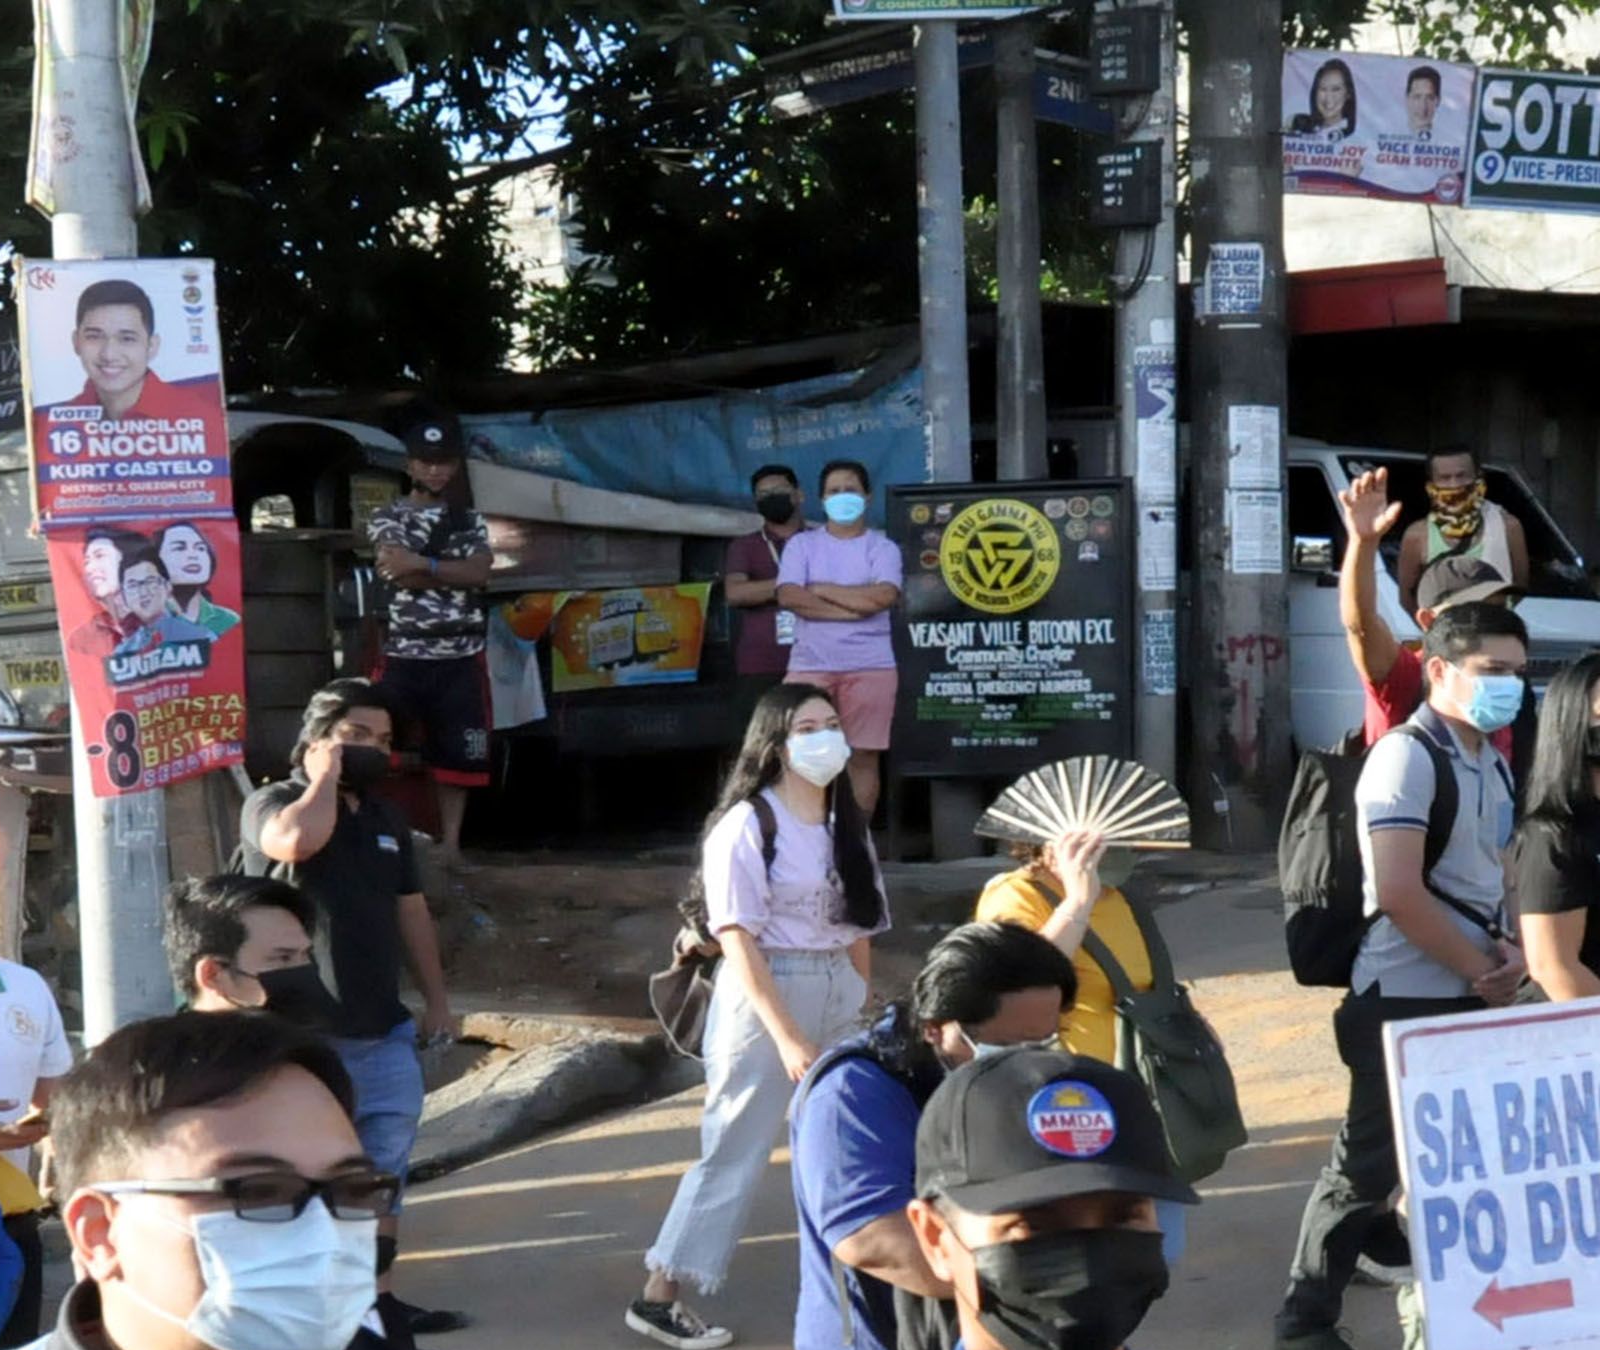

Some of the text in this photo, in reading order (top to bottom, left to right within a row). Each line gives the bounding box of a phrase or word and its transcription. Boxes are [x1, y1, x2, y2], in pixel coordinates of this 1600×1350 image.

[1284, 141, 1368, 157] MAYOR JOY
[1376, 141, 1461, 157] VICE MAYOR
[1282, 154, 1362, 169] BELMONTE
[1376, 154, 1459, 169] GIAN SOTTO
[1483, 154, 1498, 180] 9
[52, 408, 100, 420] VOTE!
[84, 419, 204, 434] COUNCILOR
[50, 431, 82, 454] 16
[88, 435, 206, 457] NOCUM
[50, 460, 214, 479] KURT CASTELO
[60, 483, 114, 493] DISTRICT
[129, 481, 178, 492] QUEZON
[180, 480, 206, 490] CITY
[952, 516, 976, 539] TAU
[976, 505, 1028, 521] GAMMA
[980, 621, 1024, 646] VILLE
[946, 645, 1075, 665] Community Chapter
[138, 694, 245, 726] BAUTISTA
[140, 712, 242, 745] HERBERT
[104, 710, 142, 789] 8
[144, 727, 240, 768] BISTEK
[1040, 1113, 1106, 1129] MMDA
[1413, 1087, 1487, 1188] SA
[1422, 1189, 1507, 1282] PO
